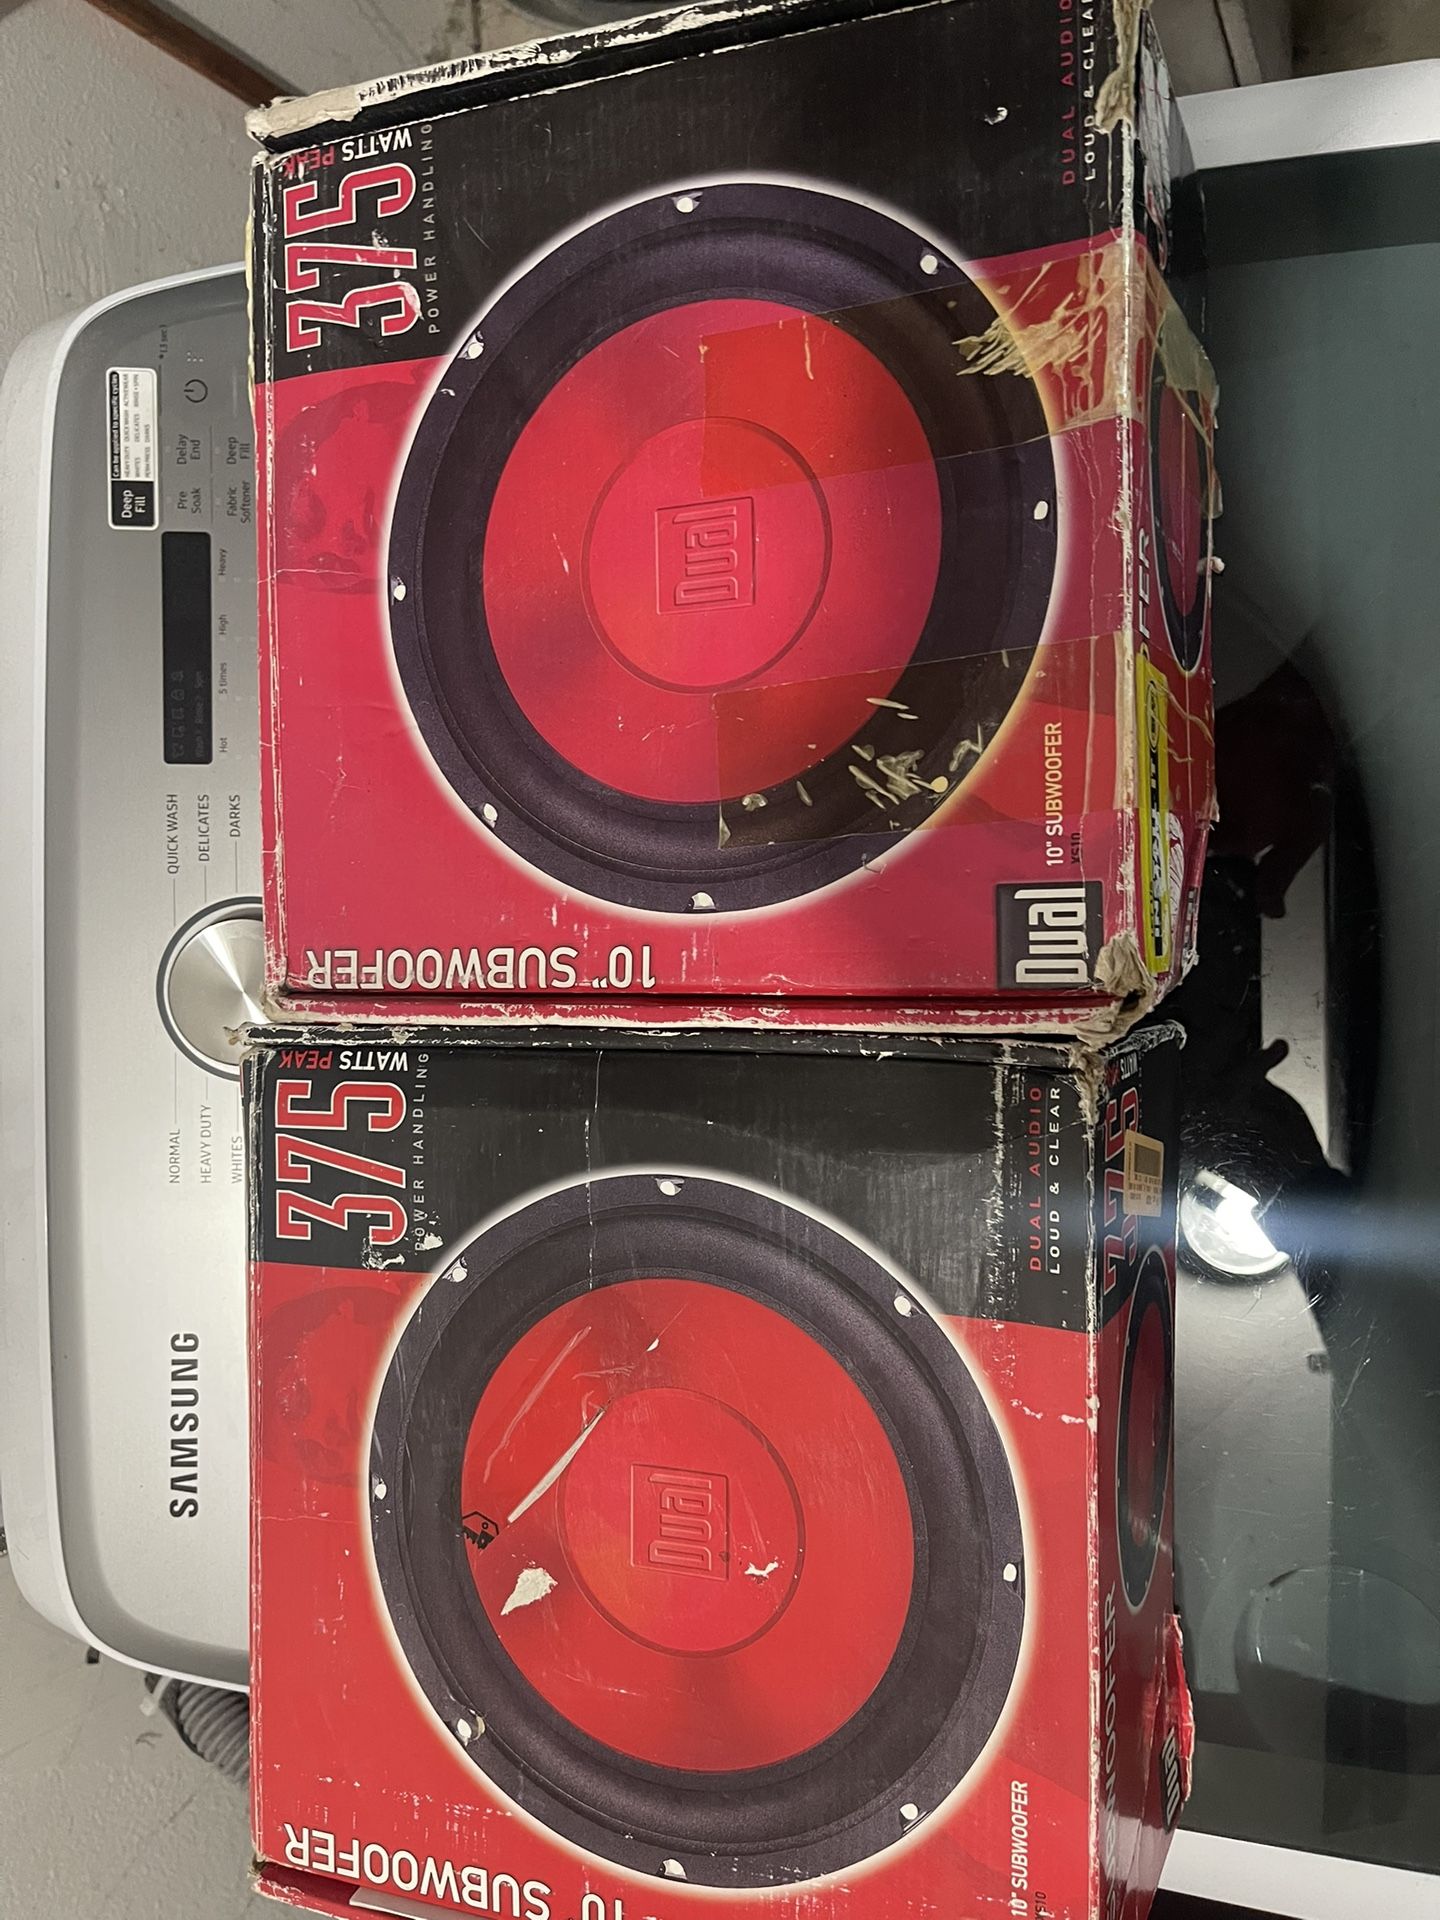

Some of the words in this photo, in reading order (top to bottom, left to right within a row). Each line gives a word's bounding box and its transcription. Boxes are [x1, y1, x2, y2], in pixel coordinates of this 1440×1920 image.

[1059, 0, 1076, 87] AUDIO
[1083, 85, 1096, 98] &
[282, 144, 337, 178] PEAK
[340, 126, 413, 162] WATTS
[1060, 105, 1076, 185] DUAL
[1083, 114, 1097, 181] LOUD
[420, 123, 438, 240] HANDLING
[283, 161, 421, 353] 375
[424, 255, 441, 334] POWER
[176, 434, 191, 465] Delay
[190, 439, 201, 461] End
[226, 436, 240, 465] Deep
[239, 442, 251, 460] Fill
[120, 489, 135, 518] Deep
[134, 495, 147, 513] Fill
[176, 490, 189, 510] Pre
[190, 487, 202, 515] Soak
[225, 486, 238, 517] Fabric
[239, 480, 252, 524] Softener
[217, 548, 228, 576] Heavy
[671, 506, 739, 607] Dual
[218, 614, 230, 636] High
[218, 662, 228, 687] times
[219, 737, 229, 754] Hot
[1044, 721, 1064, 837] SUBWOOFER
[167, 793, 180, 832] WASH
[198, 793, 211, 862] DELICATES
[229, 793, 242, 838] DARKS
[167, 834, 181, 875] QUICK
[1045, 841, 1065, 866] 10"
[1013, 887, 1089, 983] Dual
[305, 945, 579, 990] SUBWOOFER
[591, 944, 657, 989] 10"
[277, 1050, 334, 1070] PEAK
[338, 1050, 409, 1072] WATTS
[199, 1104, 212, 1139] DUTY
[412, 1053, 430, 1165] HANDLING
[1048, 1086, 1061, 1167] CLEAR
[1028, 1086, 1042, 1178] AUDIO
[168, 1128, 181, 1184] NORMAL
[200, 1140, 213, 1184] HEAVY
[231, 1135, 244, 1184] WHITES
[274, 1079, 408, 1247] 375
[1049, 1181, 1061, 1195] &
[412, 1179, 428, 1252] POWER
[1029, 1196, 1042, 1272] DUAL
[1049, 1209, 1061, 1276] LOUD
[168, 1333, 199, 1519] SAMSUNG
[647, 1473, 712, 1572] Dual
[1161, 1726, 1181, 1827] Dual
[1010, 1780, 1029, 1891] SUBWOOFER
[283, 1823, 552, 1920] SUBWOOFER
[1010, 1891, 1029, 1917] 10"
